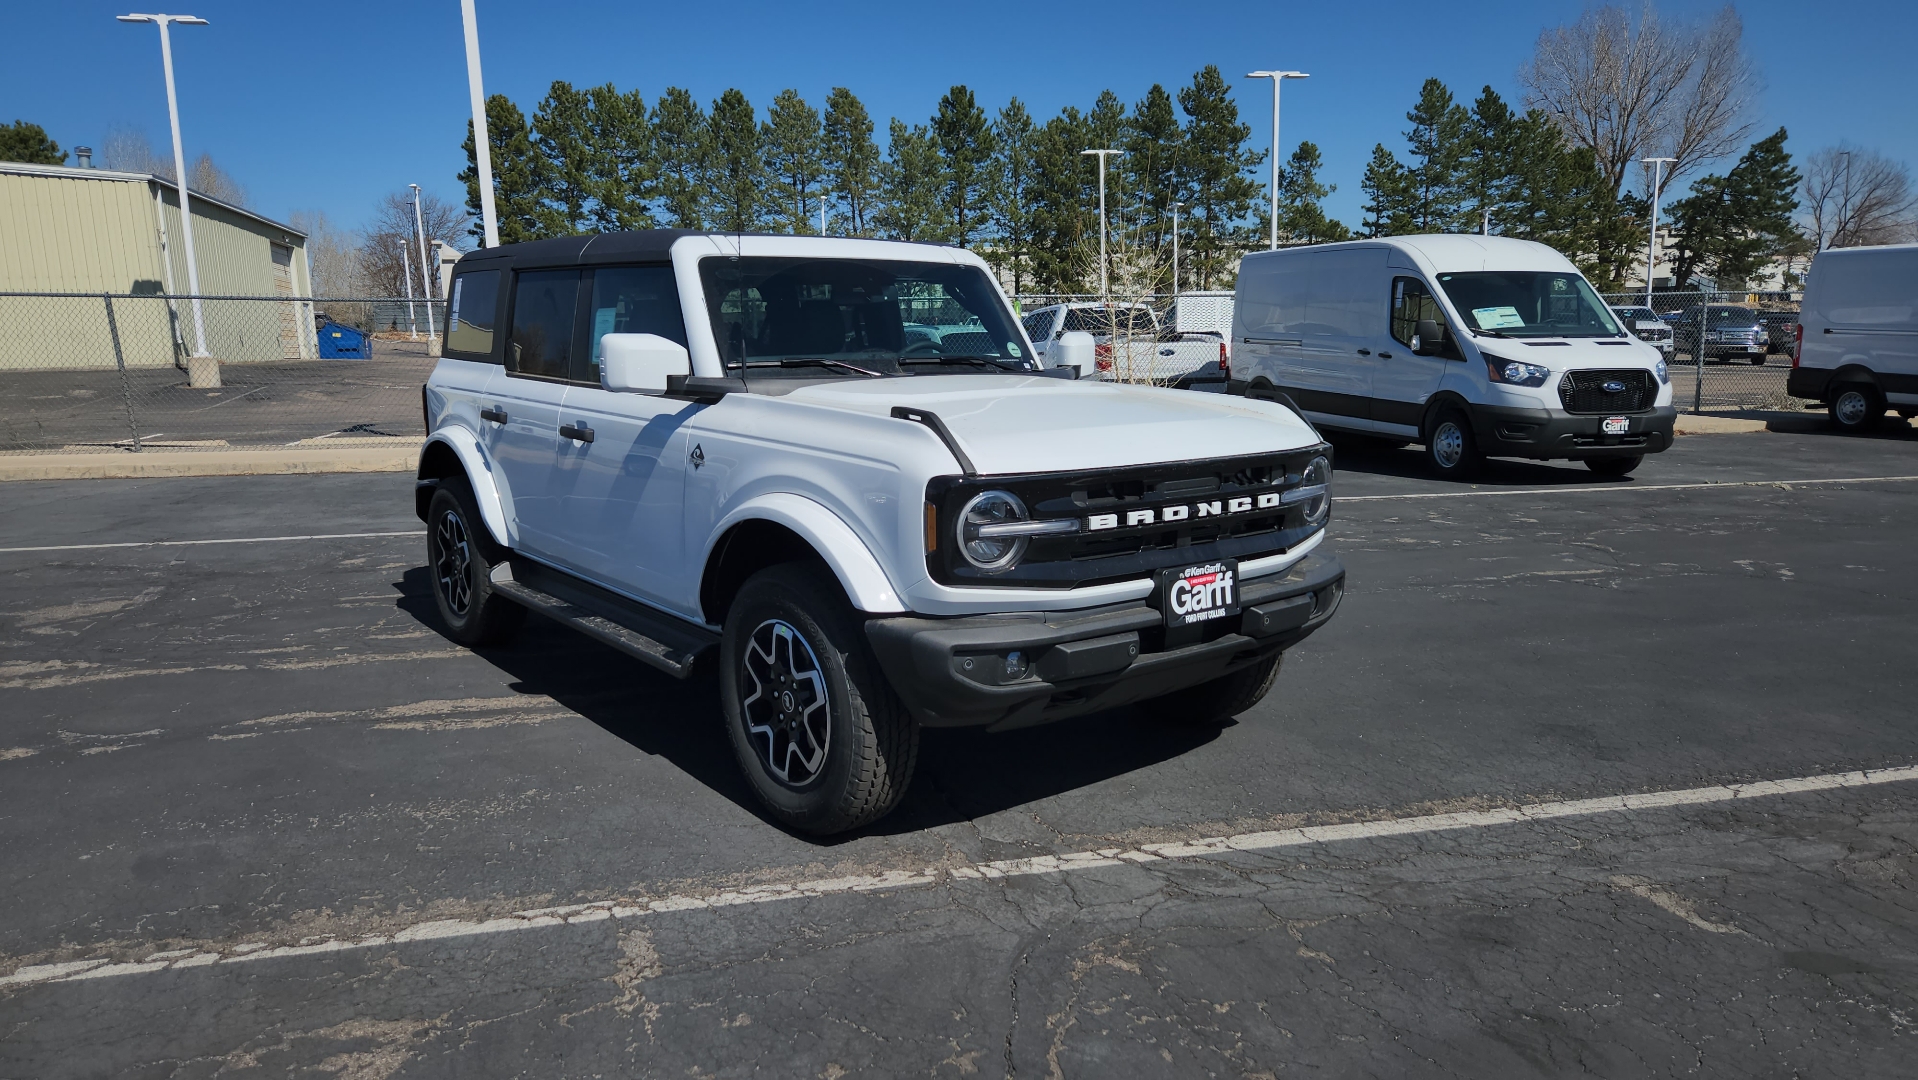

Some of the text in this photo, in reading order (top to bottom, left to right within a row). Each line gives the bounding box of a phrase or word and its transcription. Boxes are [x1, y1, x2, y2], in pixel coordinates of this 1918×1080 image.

[1602, 419, 1630, 432] Garff
[1088, 493, 1280, 530] BRONCO
[1171, 571, 1232, 614] Garff
